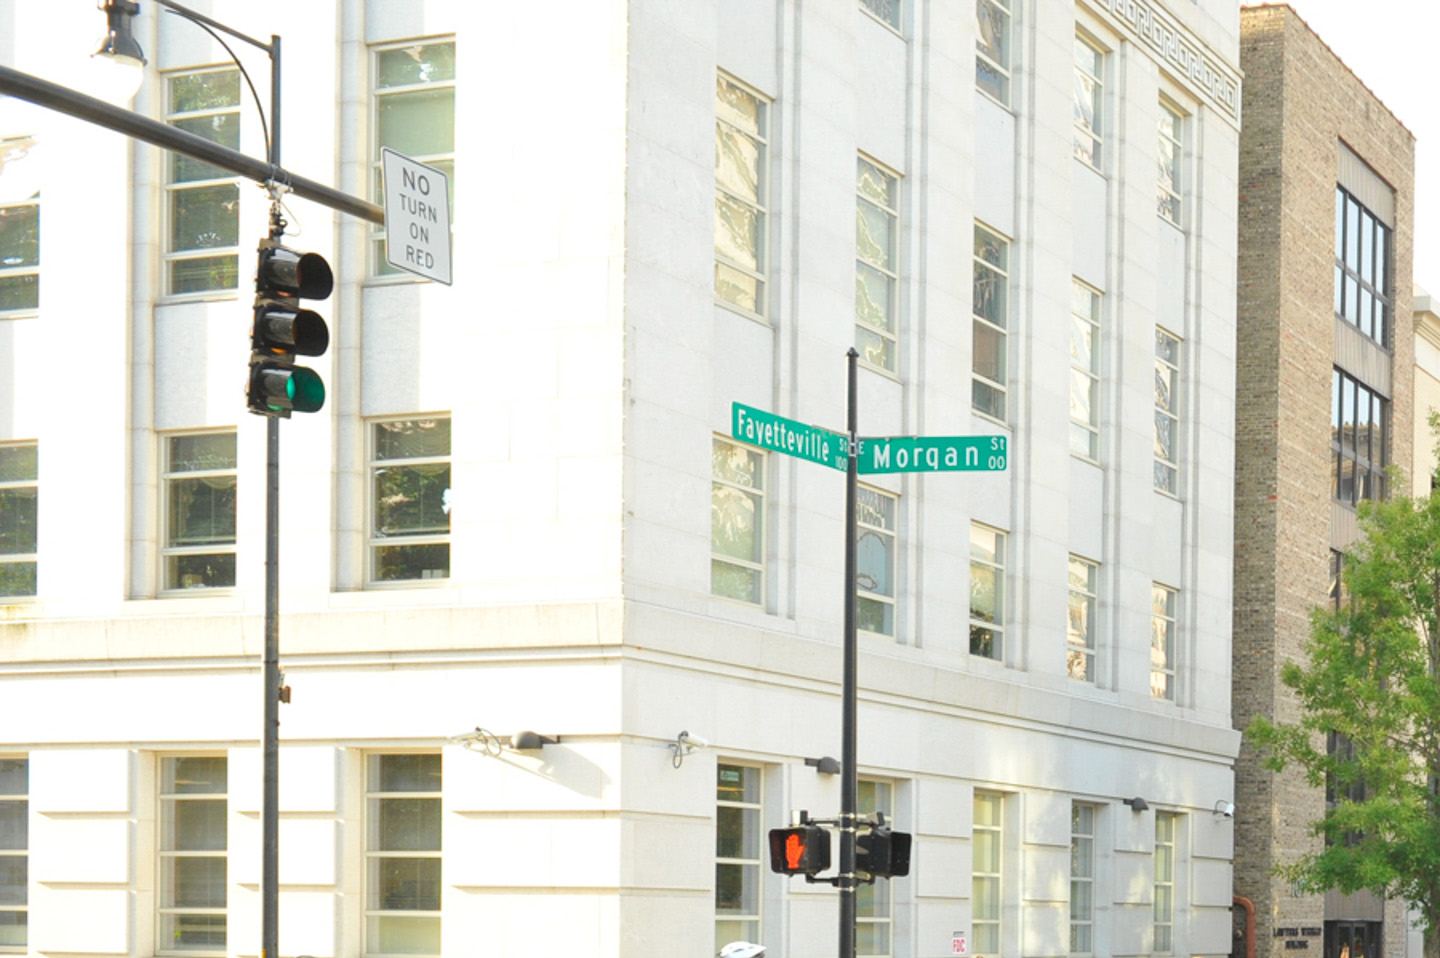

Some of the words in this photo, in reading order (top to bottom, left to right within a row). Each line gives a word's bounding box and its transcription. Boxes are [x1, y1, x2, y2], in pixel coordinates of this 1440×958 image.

[402, 167, 430, 196] NO
[399, 193, 437, 223] TURN
[409, 222, 430, 244] ON
[406, 245, 434, 269] RED
[738, 408, 829, 462] Fayetteville
[839, 438, 848, 453] St
[990, 437, 1005, 450] St
[988, 456, 1006, 469] 00
